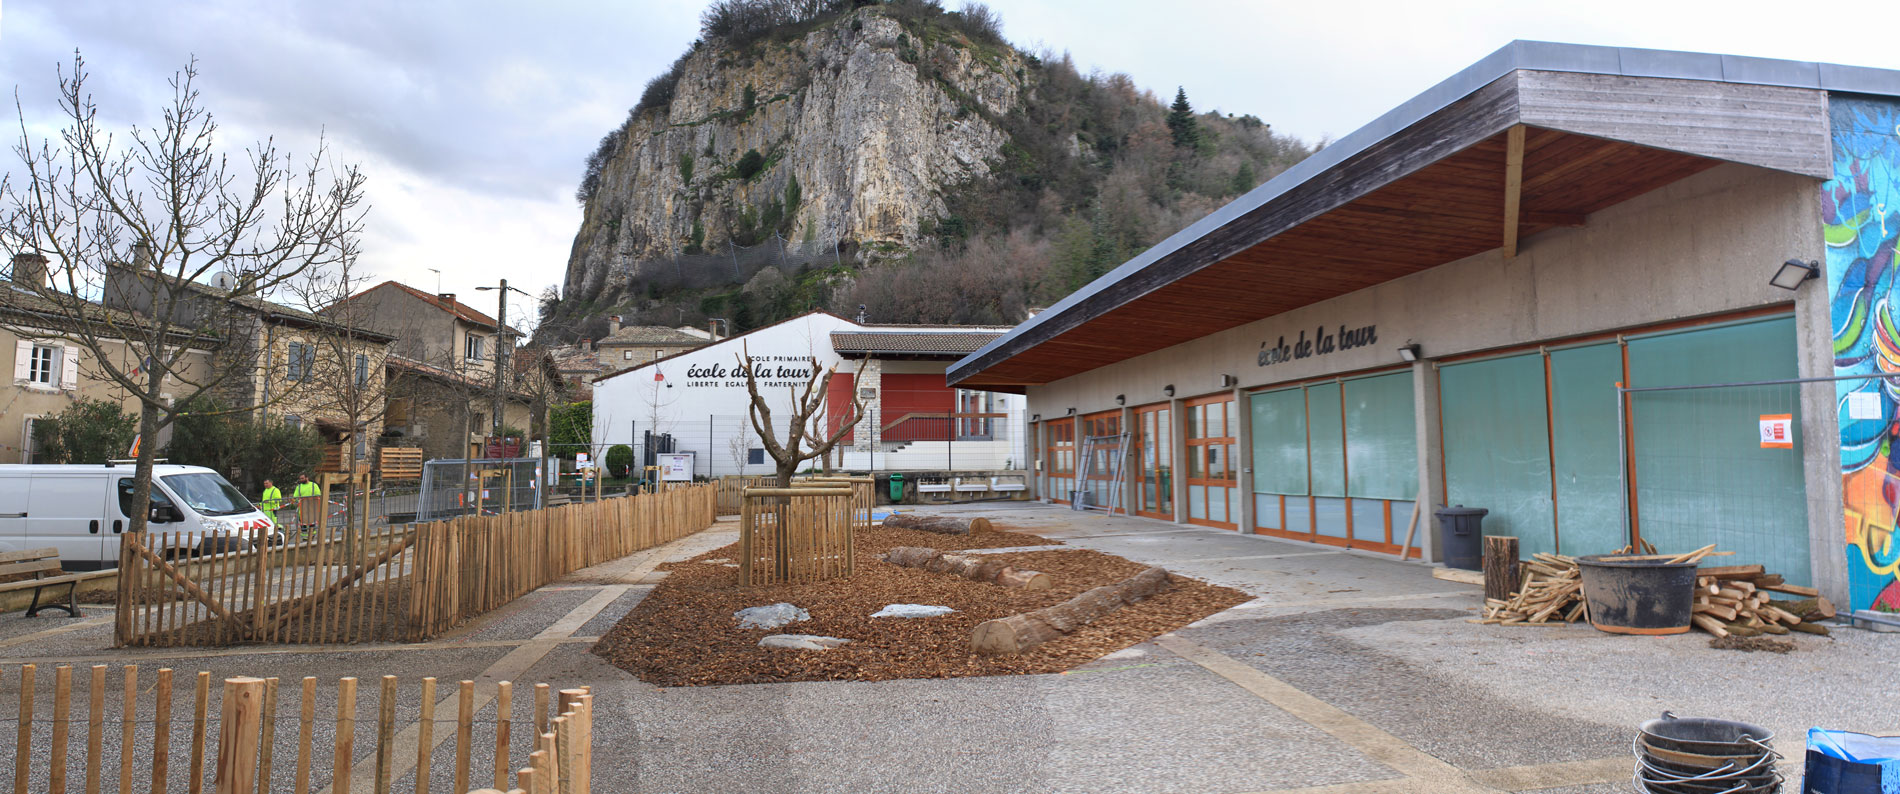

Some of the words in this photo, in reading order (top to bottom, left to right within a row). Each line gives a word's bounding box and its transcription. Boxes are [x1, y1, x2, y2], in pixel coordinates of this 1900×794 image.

[1258, 336, 1291, 367] école
[1294, 330, 1312, 359] de
[1317, 325, 1335, 355] la
[1339, 325, 1378, 351] tour
[687, 363, 726, 378] école
[755, 363, 772, 378] la
[777, 365, 810, 378] tour
